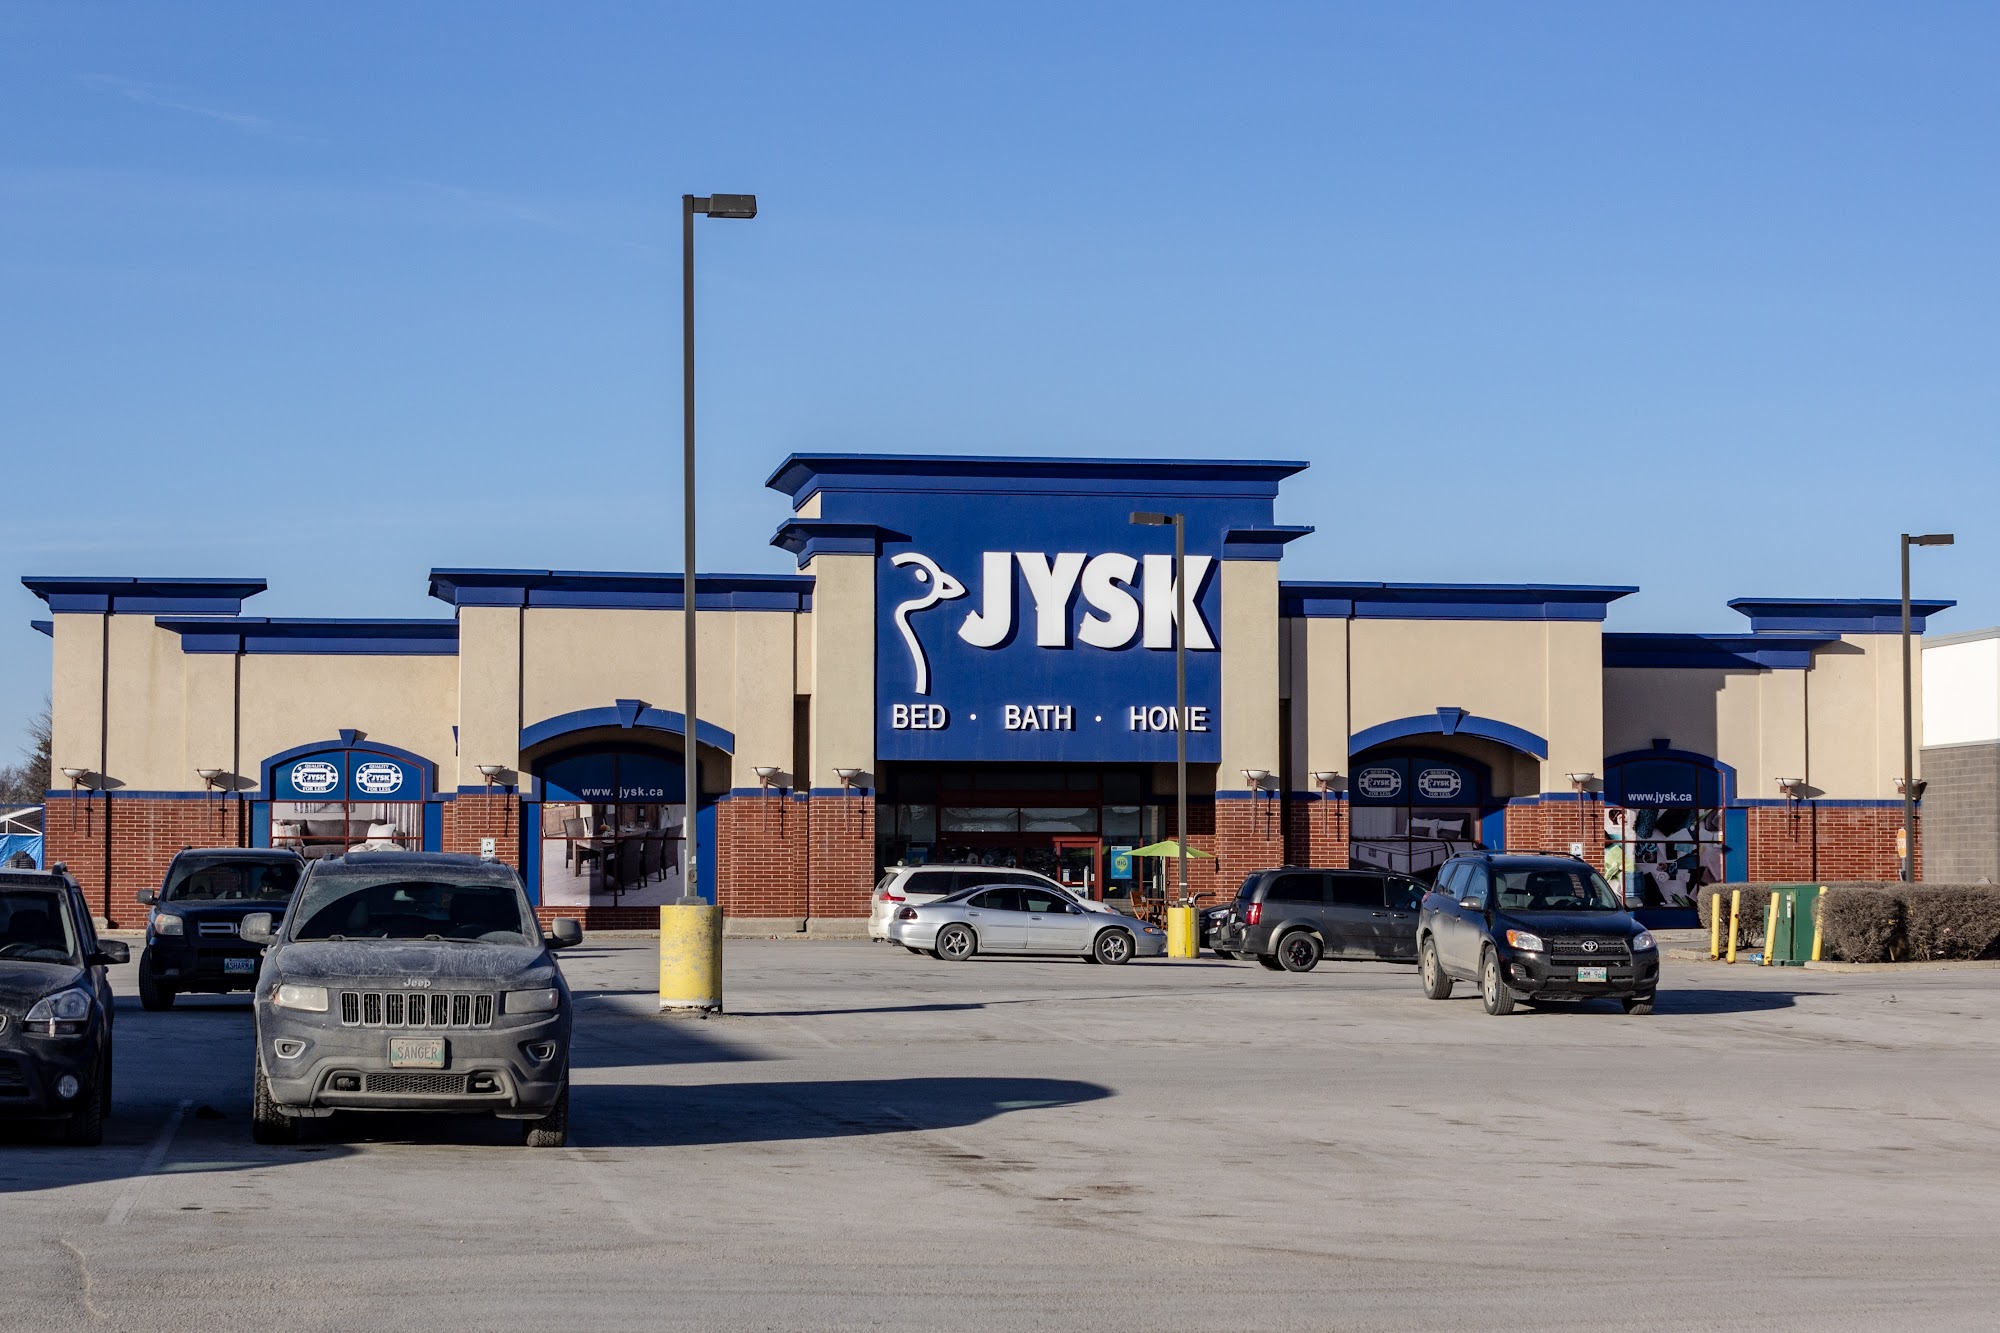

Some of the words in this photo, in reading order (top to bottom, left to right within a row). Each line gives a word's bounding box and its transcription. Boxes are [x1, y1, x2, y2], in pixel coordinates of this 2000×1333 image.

[958, 551, 1215, 649] JYSK
[892, 703, 946, 729] BED
[1004, 704, 1072, 730] BATH
[1130, 705, 1207, 731] HOME
[619, 786, 664, 798] jysk.ca
[1627, 792, 1692, 804] www.jysk.ca
[403, 978, 432, 989] Jeep
[397, 1046, 438, 1060] SANGER
